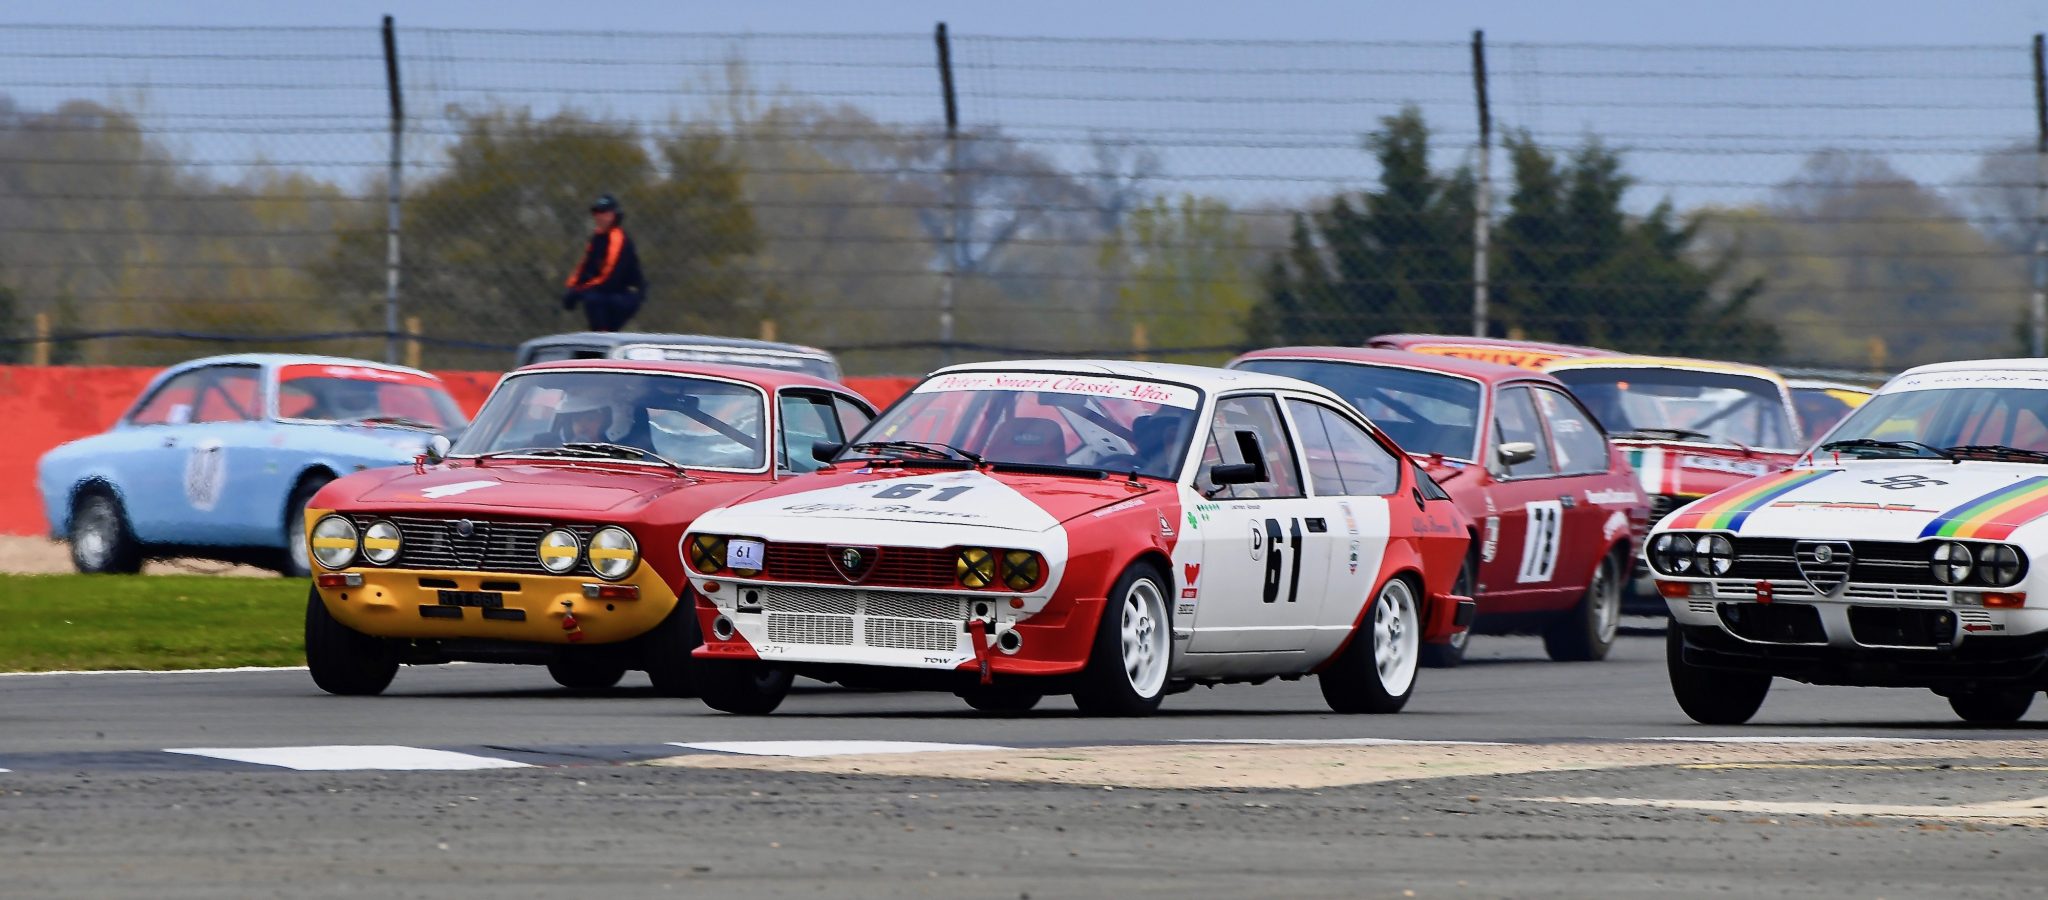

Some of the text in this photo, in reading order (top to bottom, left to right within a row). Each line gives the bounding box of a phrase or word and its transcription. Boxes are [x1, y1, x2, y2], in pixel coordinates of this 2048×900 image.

[989, 374, 1048, 389] Smart
[1052, 376, 1119, 394] Classic
[1123, 383, 1173, 402] Alfas
[872, 483, 974, 501] 61
[1252, 527, 1262, 550] D
[1526, 508, 1555, 577] 78
[736, 545, 751, 559] 61
[1262, 517, 1303, 604] 61
[923, 656, 951, 664] TOW
